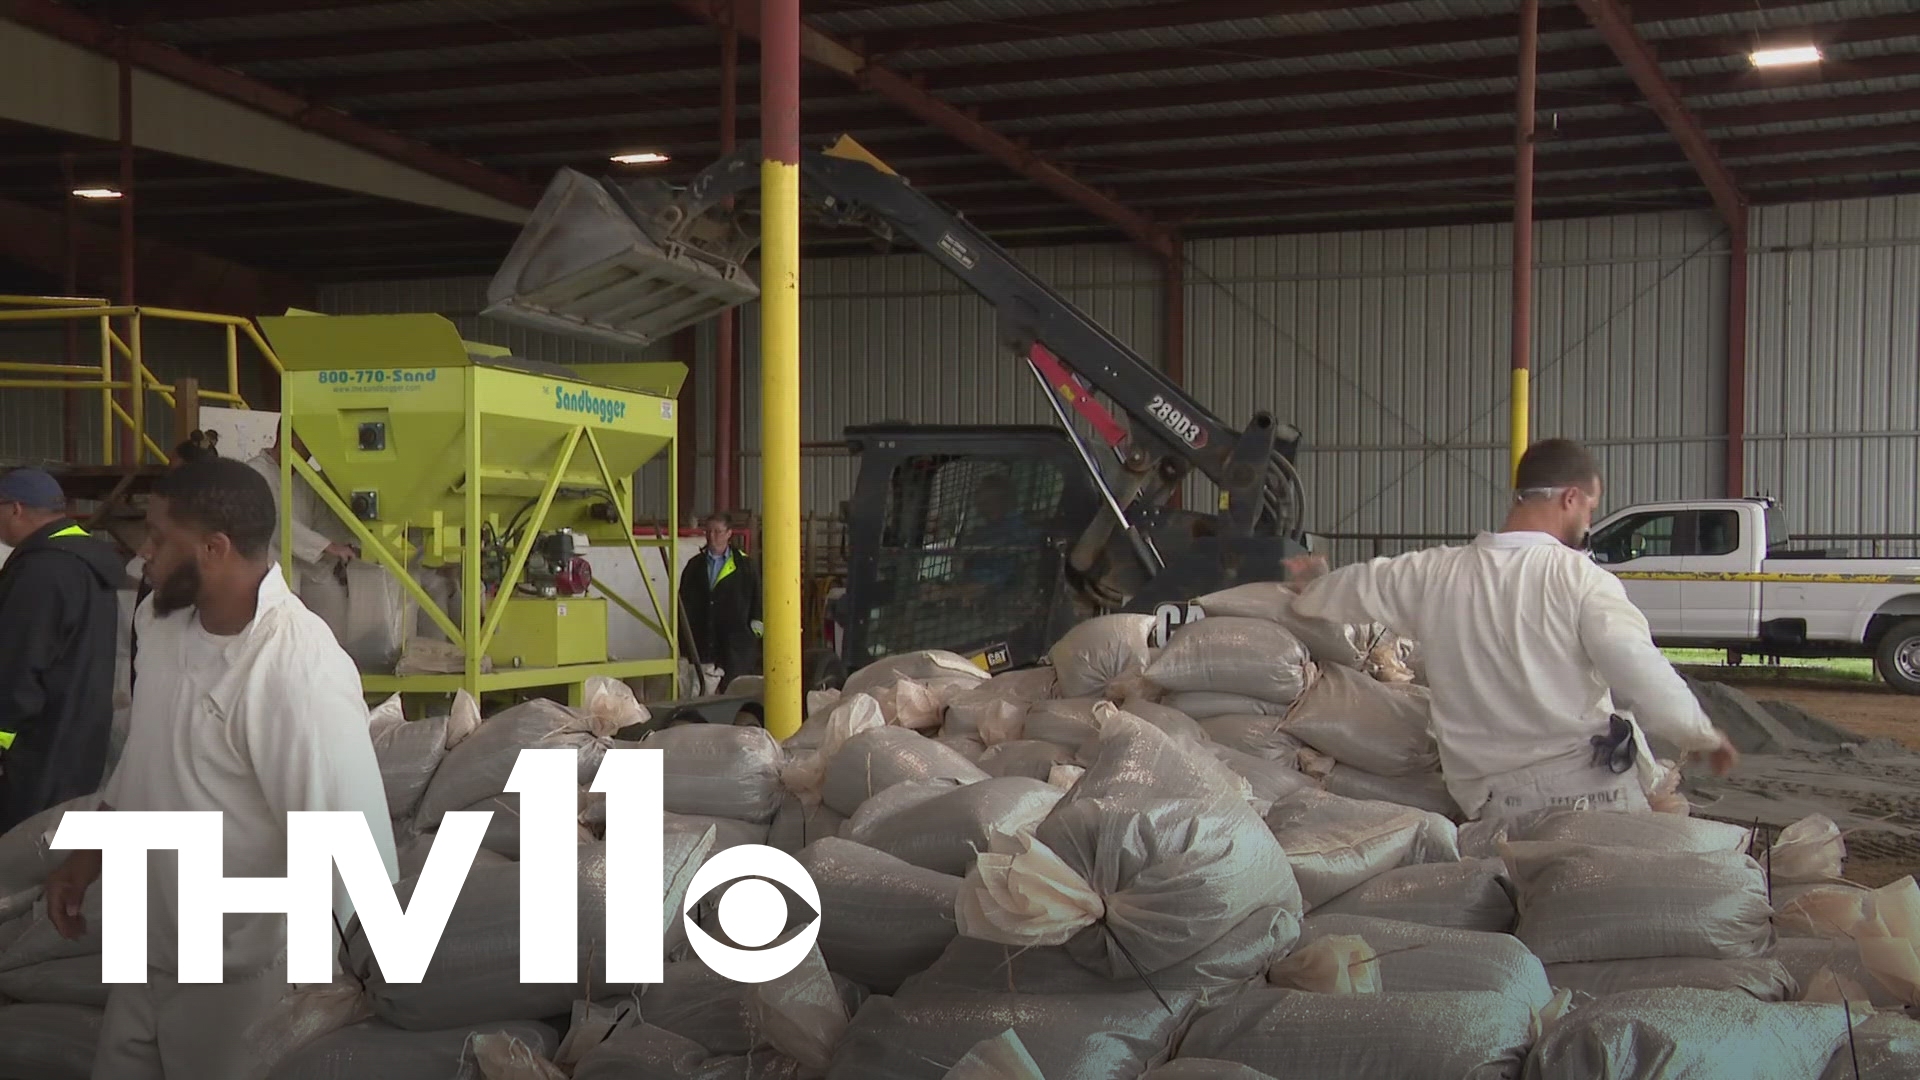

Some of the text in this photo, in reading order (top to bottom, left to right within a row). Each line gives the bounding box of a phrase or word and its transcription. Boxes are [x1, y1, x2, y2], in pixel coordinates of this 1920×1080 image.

[318, 369, 436, 384] 800-770-Sand
[555, 386, 626, 424] Sandbagger
[1147, 395, 1200, 442] 289D3
[987, 650, 1006, 667] CAT
